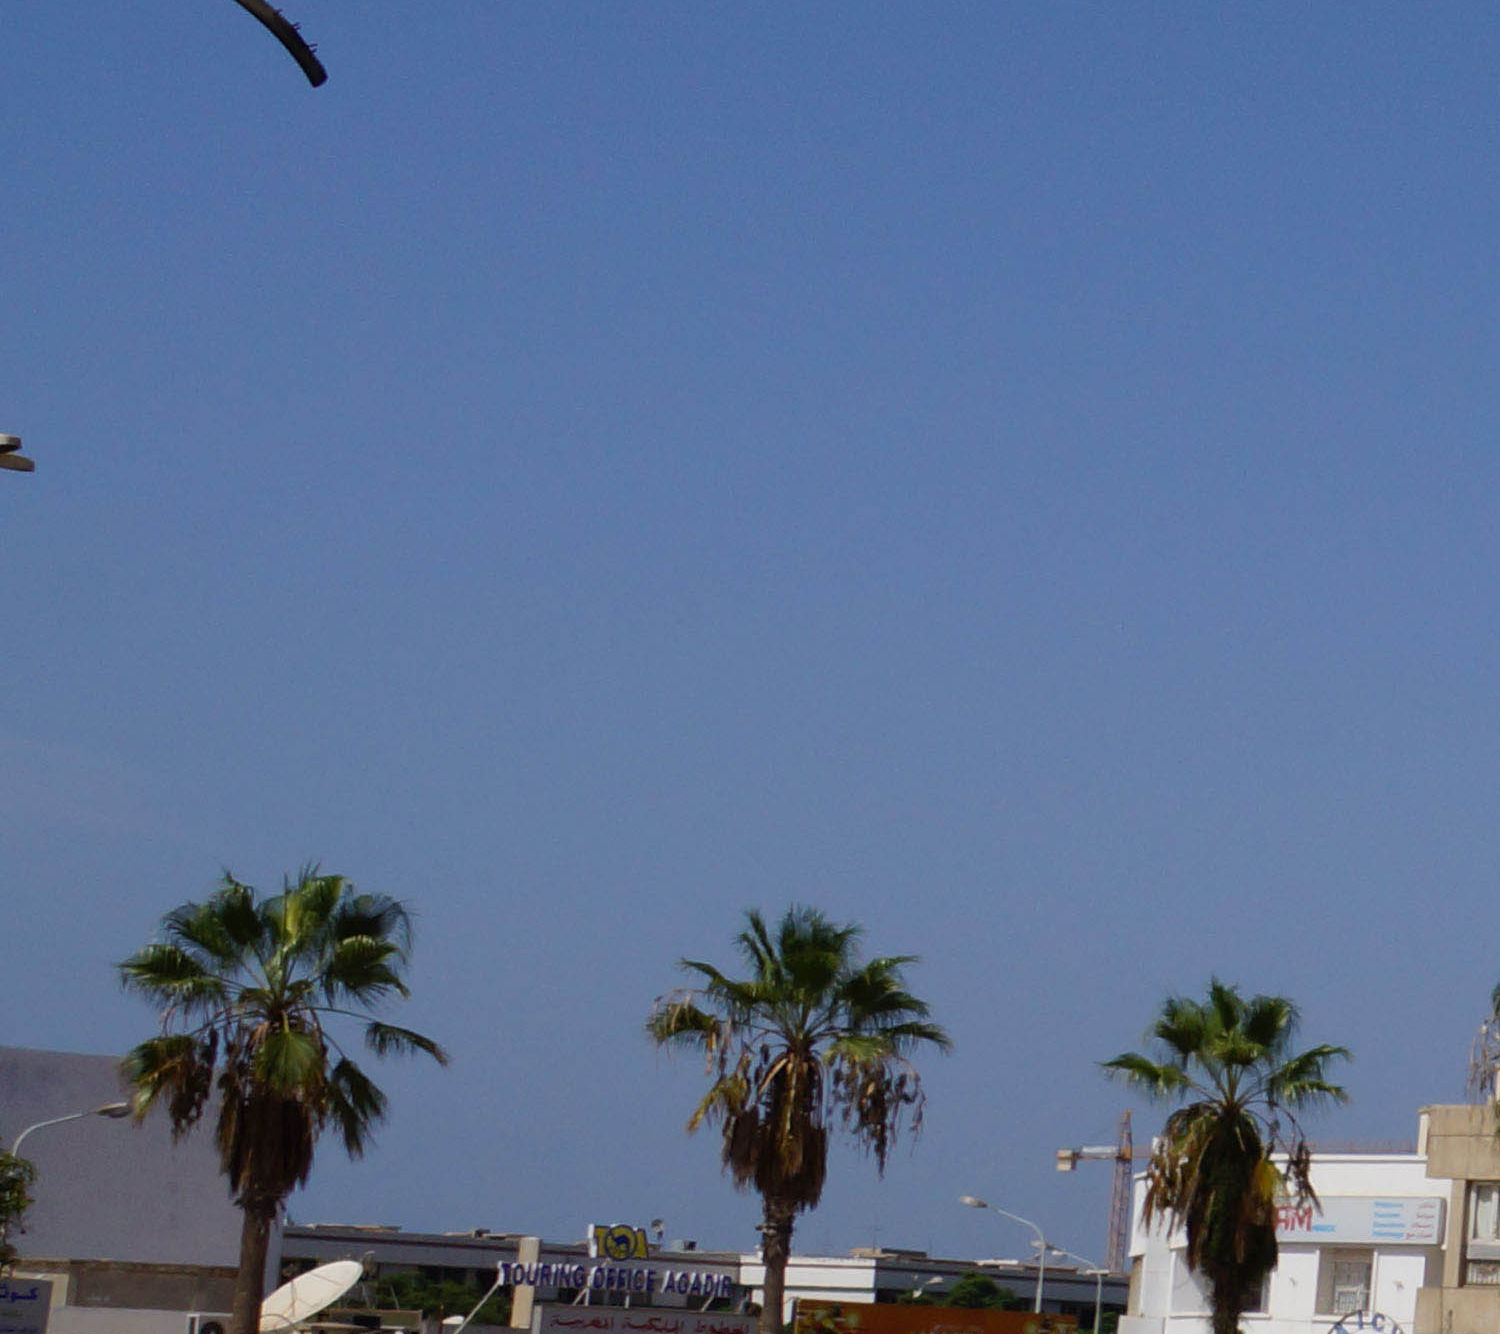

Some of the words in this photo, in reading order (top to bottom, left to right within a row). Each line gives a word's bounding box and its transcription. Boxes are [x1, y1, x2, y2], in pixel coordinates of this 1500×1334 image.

[500, 1263, 586, 1288] TOURING
[591, 1266, 655, 1292] OFFICE
[662, 1270, 733, 1298] AGADIR
